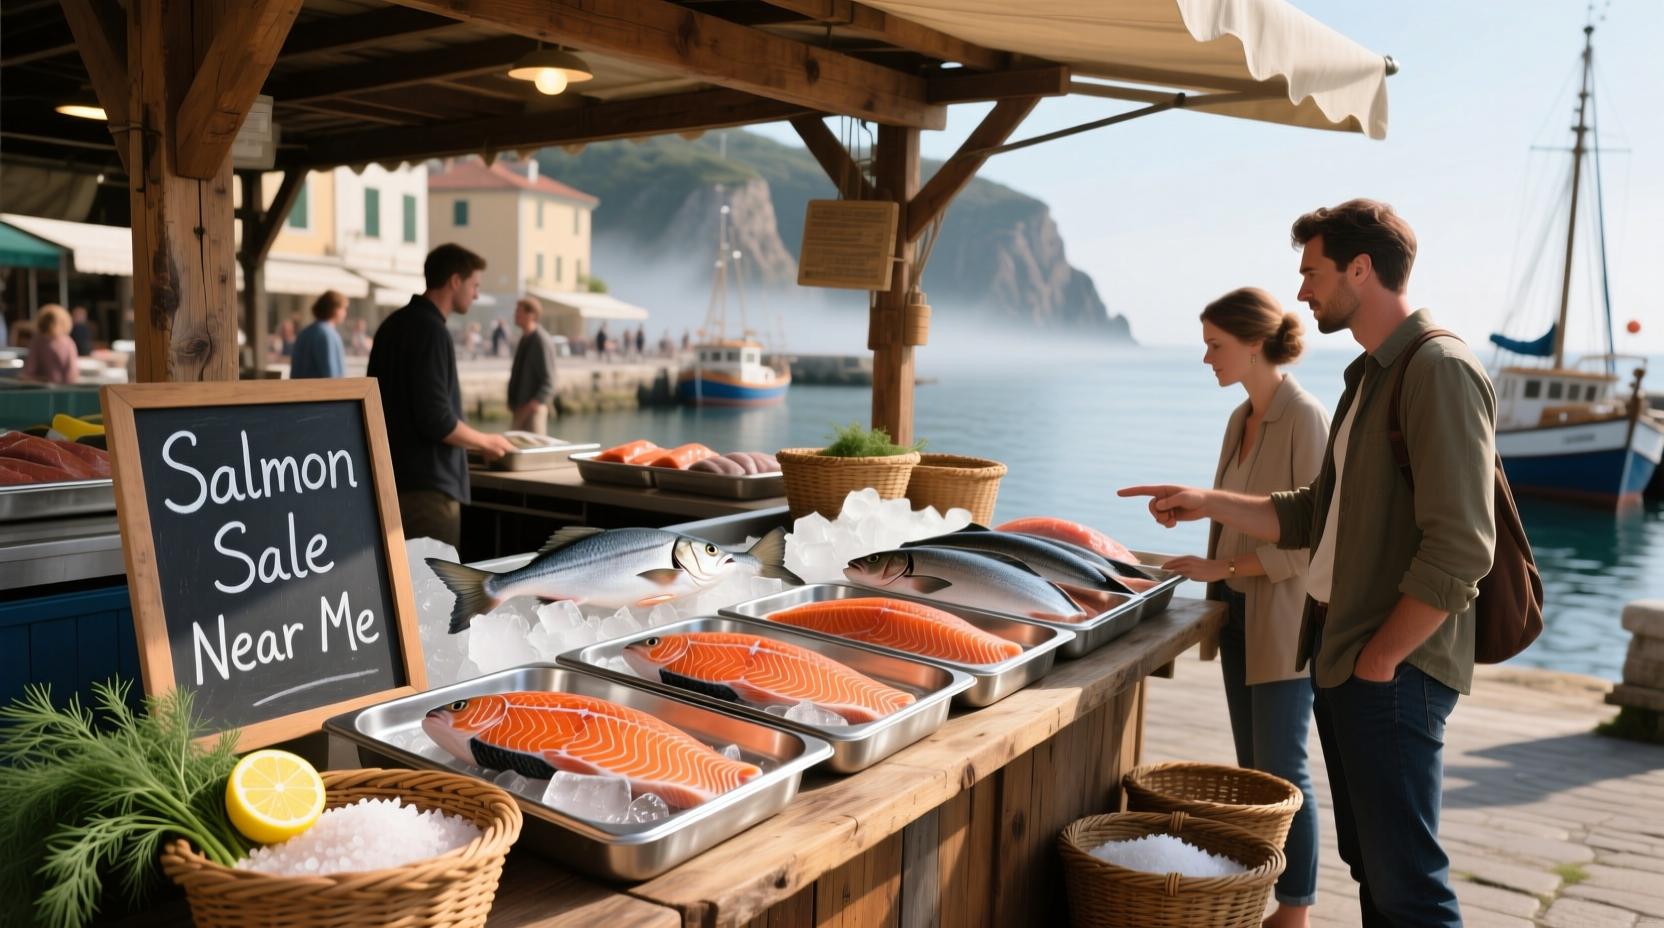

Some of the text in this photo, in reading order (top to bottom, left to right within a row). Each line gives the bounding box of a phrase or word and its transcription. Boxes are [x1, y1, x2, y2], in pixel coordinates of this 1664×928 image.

[162, 430, 357, 514] Salmon
[214, 512, 334, 593] Sale
[192, 591, 379, 685] Near Me
